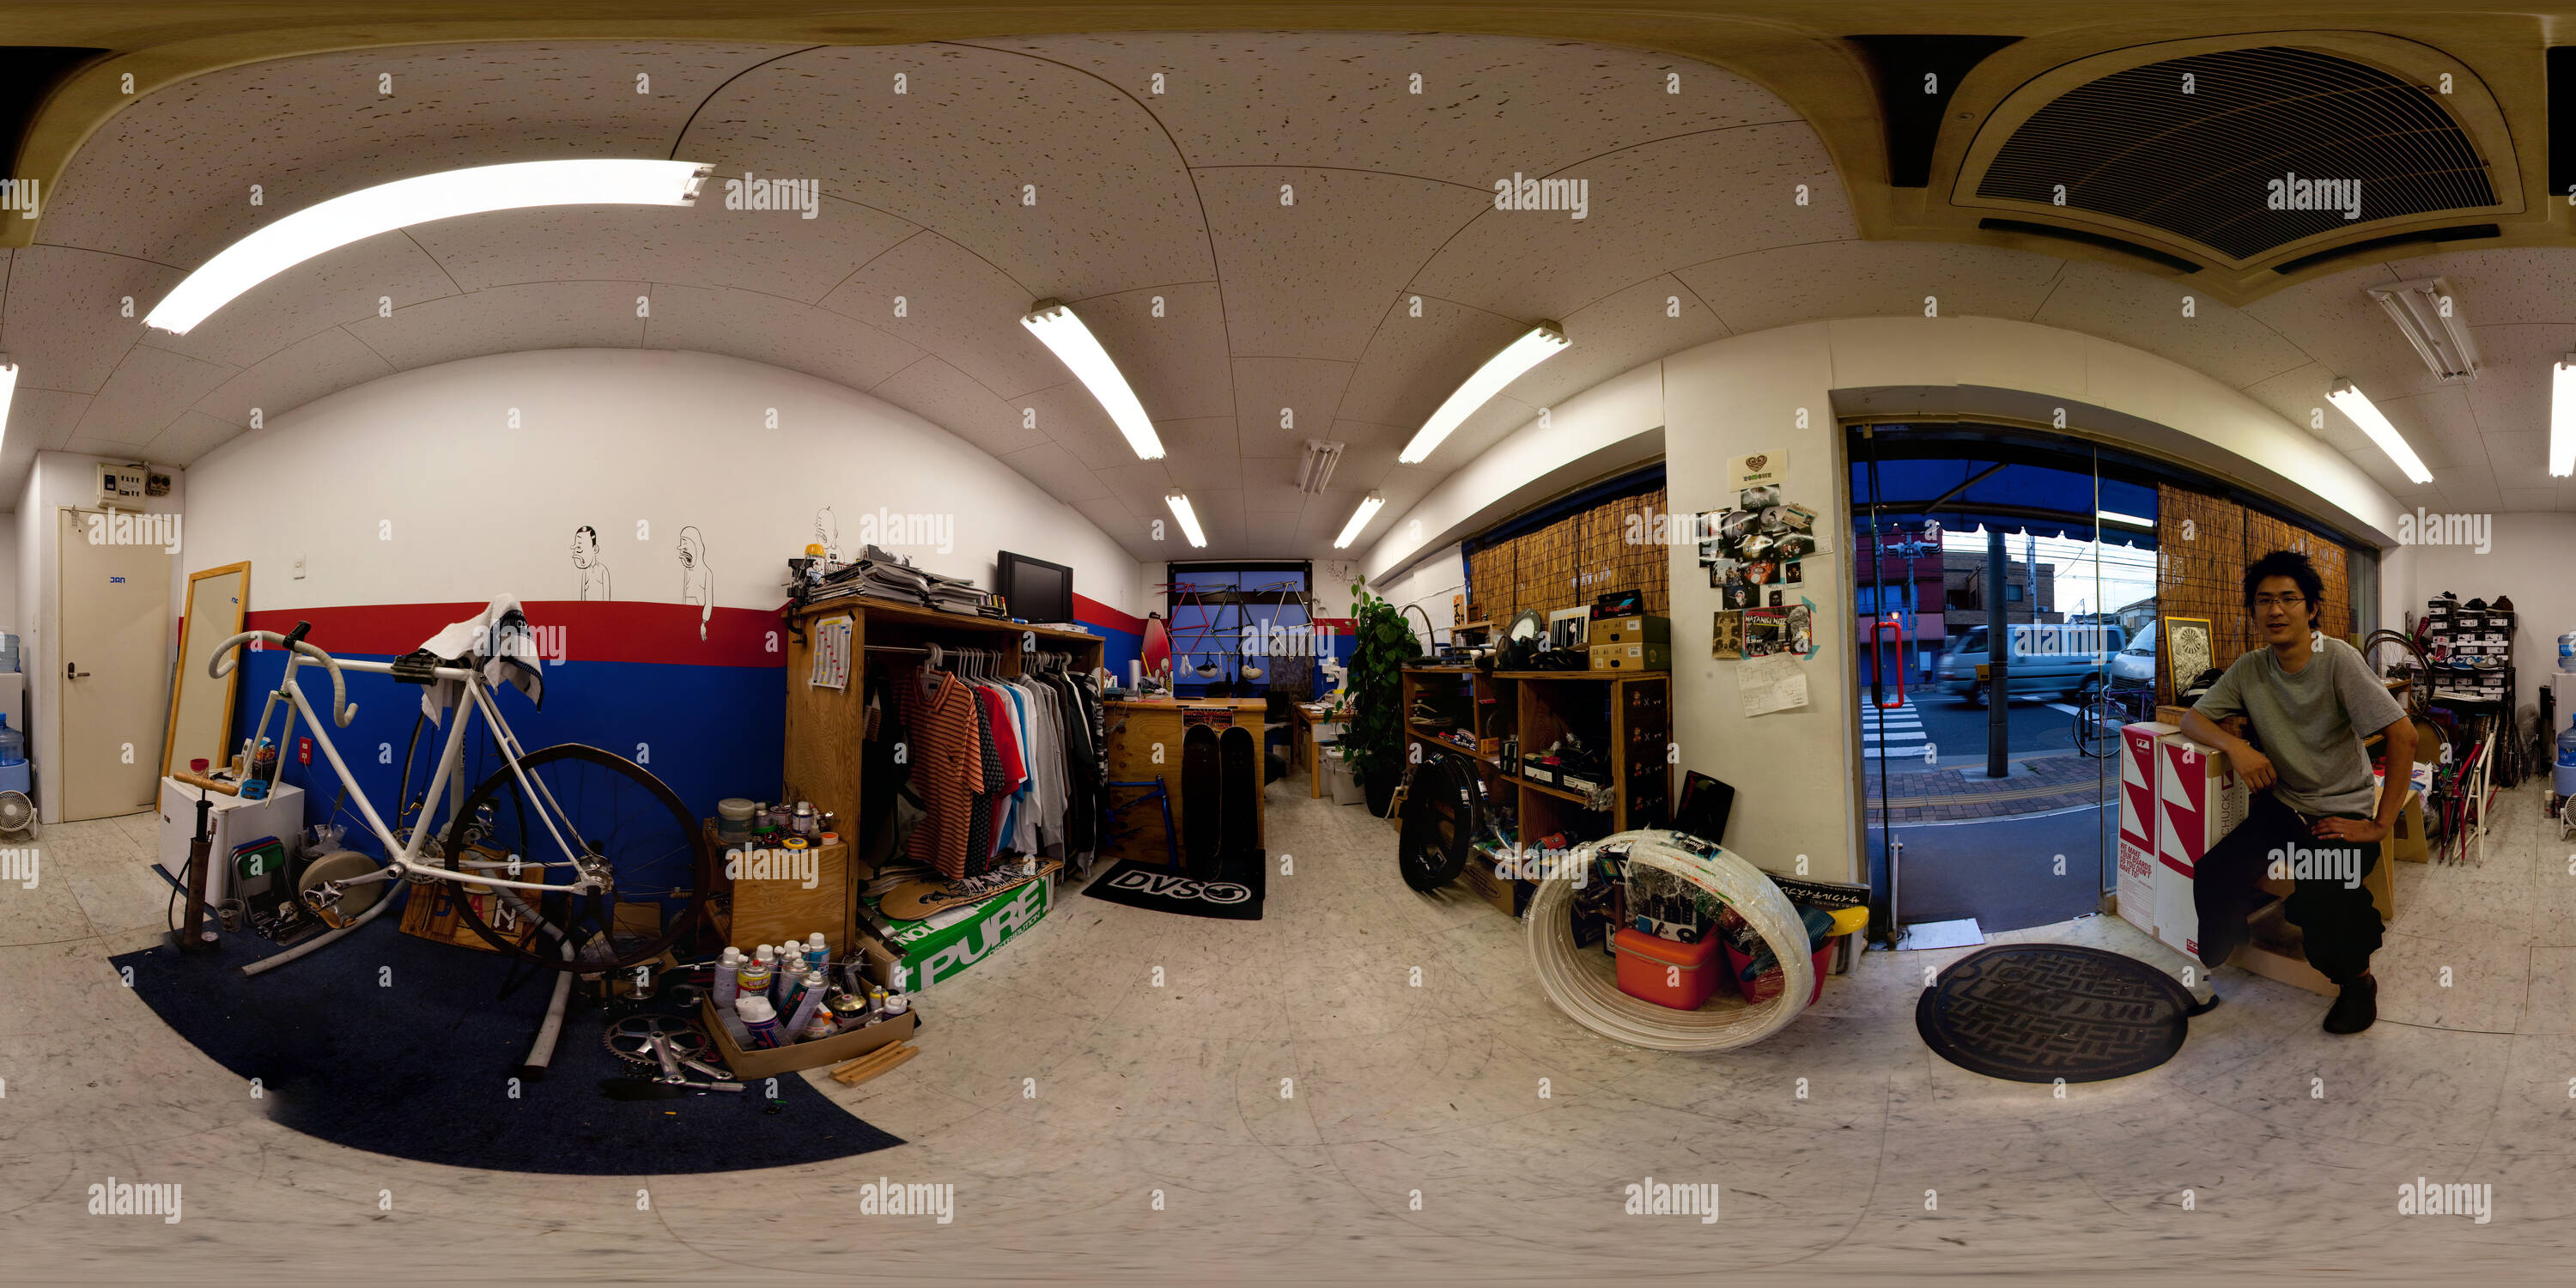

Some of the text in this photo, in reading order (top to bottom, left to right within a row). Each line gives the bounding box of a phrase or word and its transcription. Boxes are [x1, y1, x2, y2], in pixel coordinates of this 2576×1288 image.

[2120, 849, 2132, 861] YOUR
[2128, 846, 2142, 859] MAKE
[2119, 855, 2153, 879] SO YOU DON'T
[2119, 862, 2131, 875] HAVE
[1108, 869, 1205, 900] DVS
